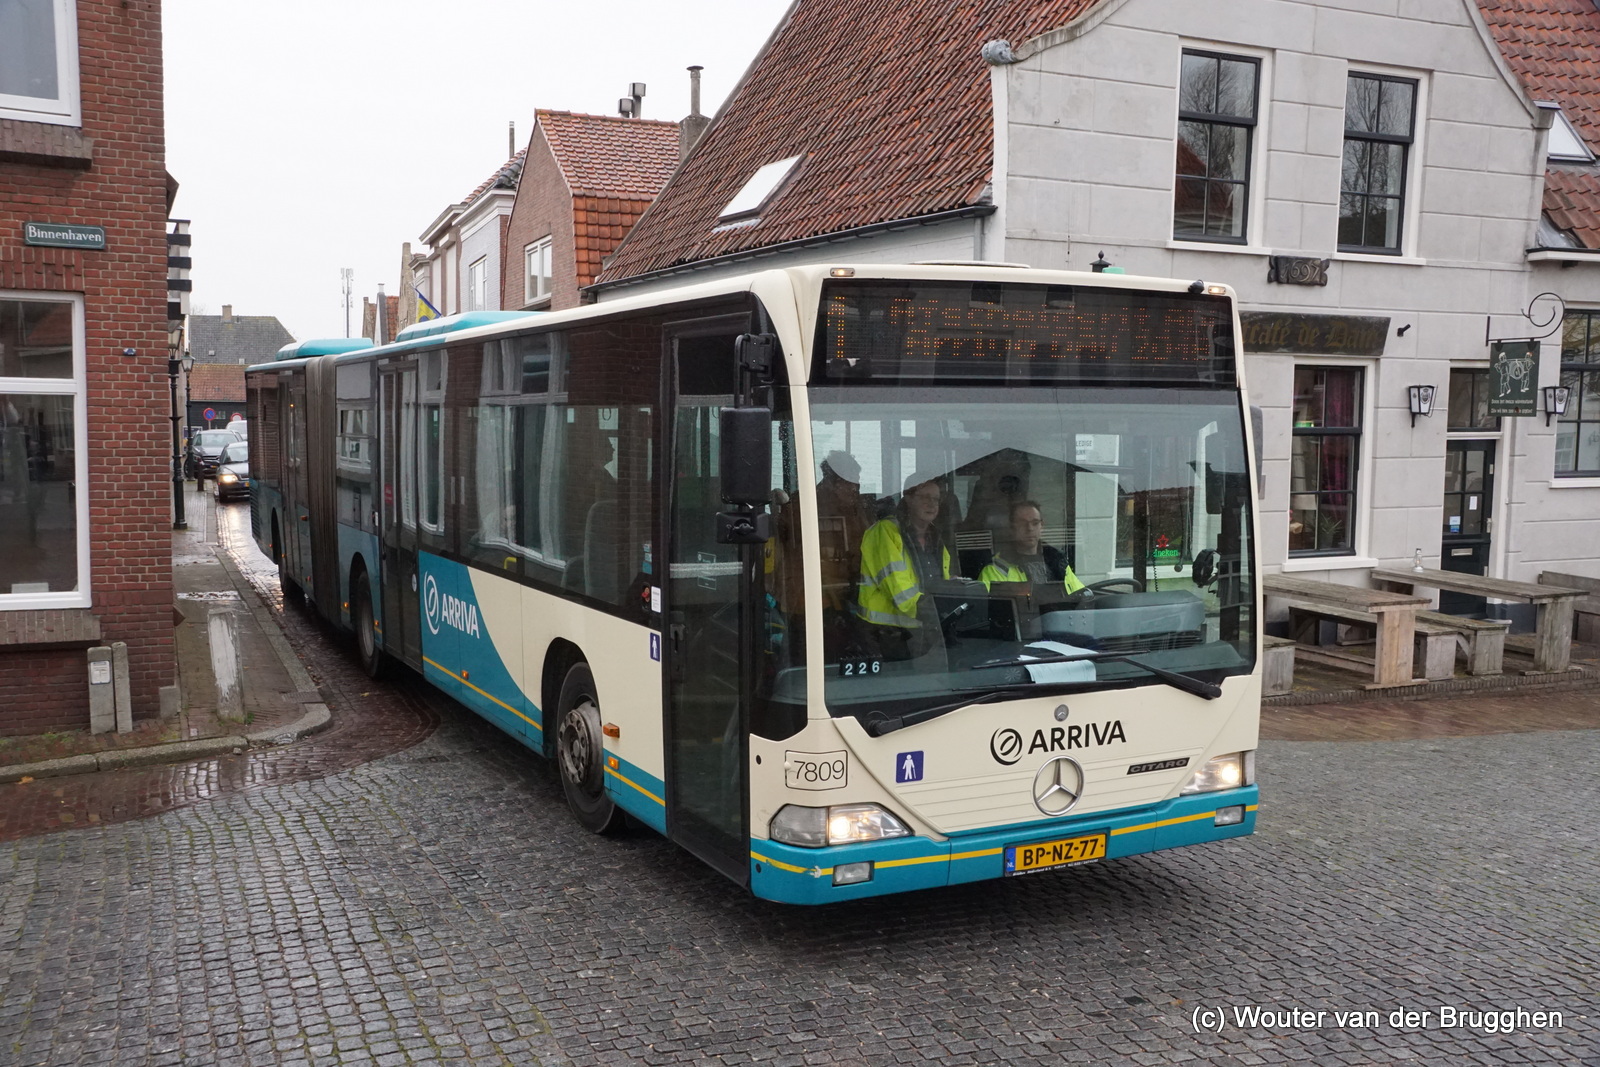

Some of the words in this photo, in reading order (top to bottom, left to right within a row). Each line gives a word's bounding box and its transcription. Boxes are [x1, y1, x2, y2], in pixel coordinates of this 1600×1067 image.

[28, 225, 102, 242] Binnenhaven
[1297, 321, 1320, 346] de
[442, 593, 480, 639] ARRIVA
[845, 661, 880, 675] 226
[1028, 720, 1126, 755] ARRIVA
[794, 760, 844, 782] 7809
[1130, 759, 1187, 773] CITARO
[1023, 838, 1099, 867] BP-NZ-77
